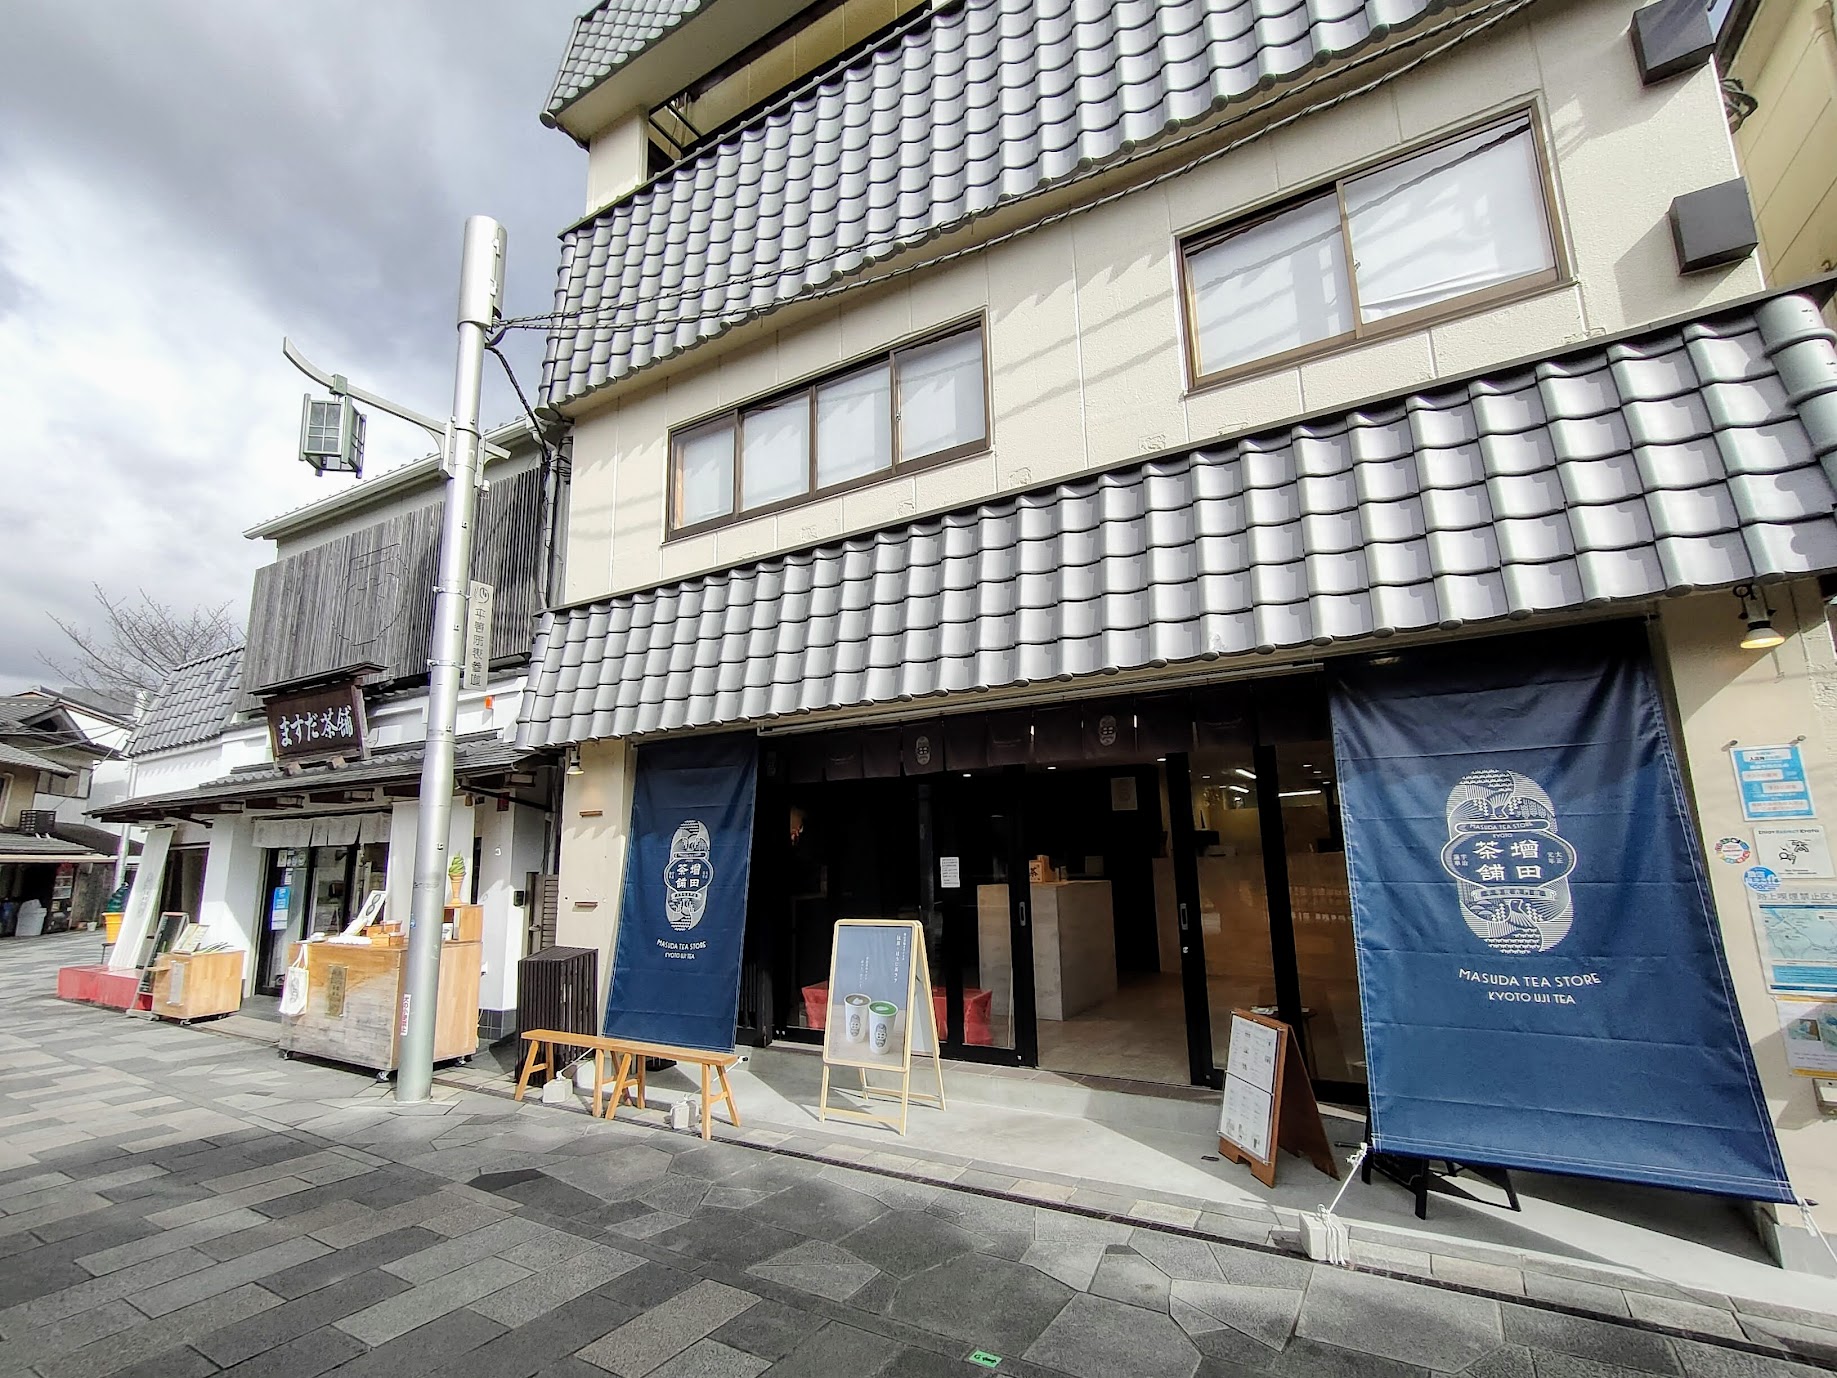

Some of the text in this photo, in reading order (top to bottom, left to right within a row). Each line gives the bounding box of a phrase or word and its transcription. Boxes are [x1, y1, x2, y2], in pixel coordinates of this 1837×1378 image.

[656, 938, 678, 950] MASUDA
[689, 941, 707, 950] STORE
[1459, 968, 1602, 988] MASUDA TEA STORE
[1488, 991, 1576, 1005] KYOTO UJI TEA
